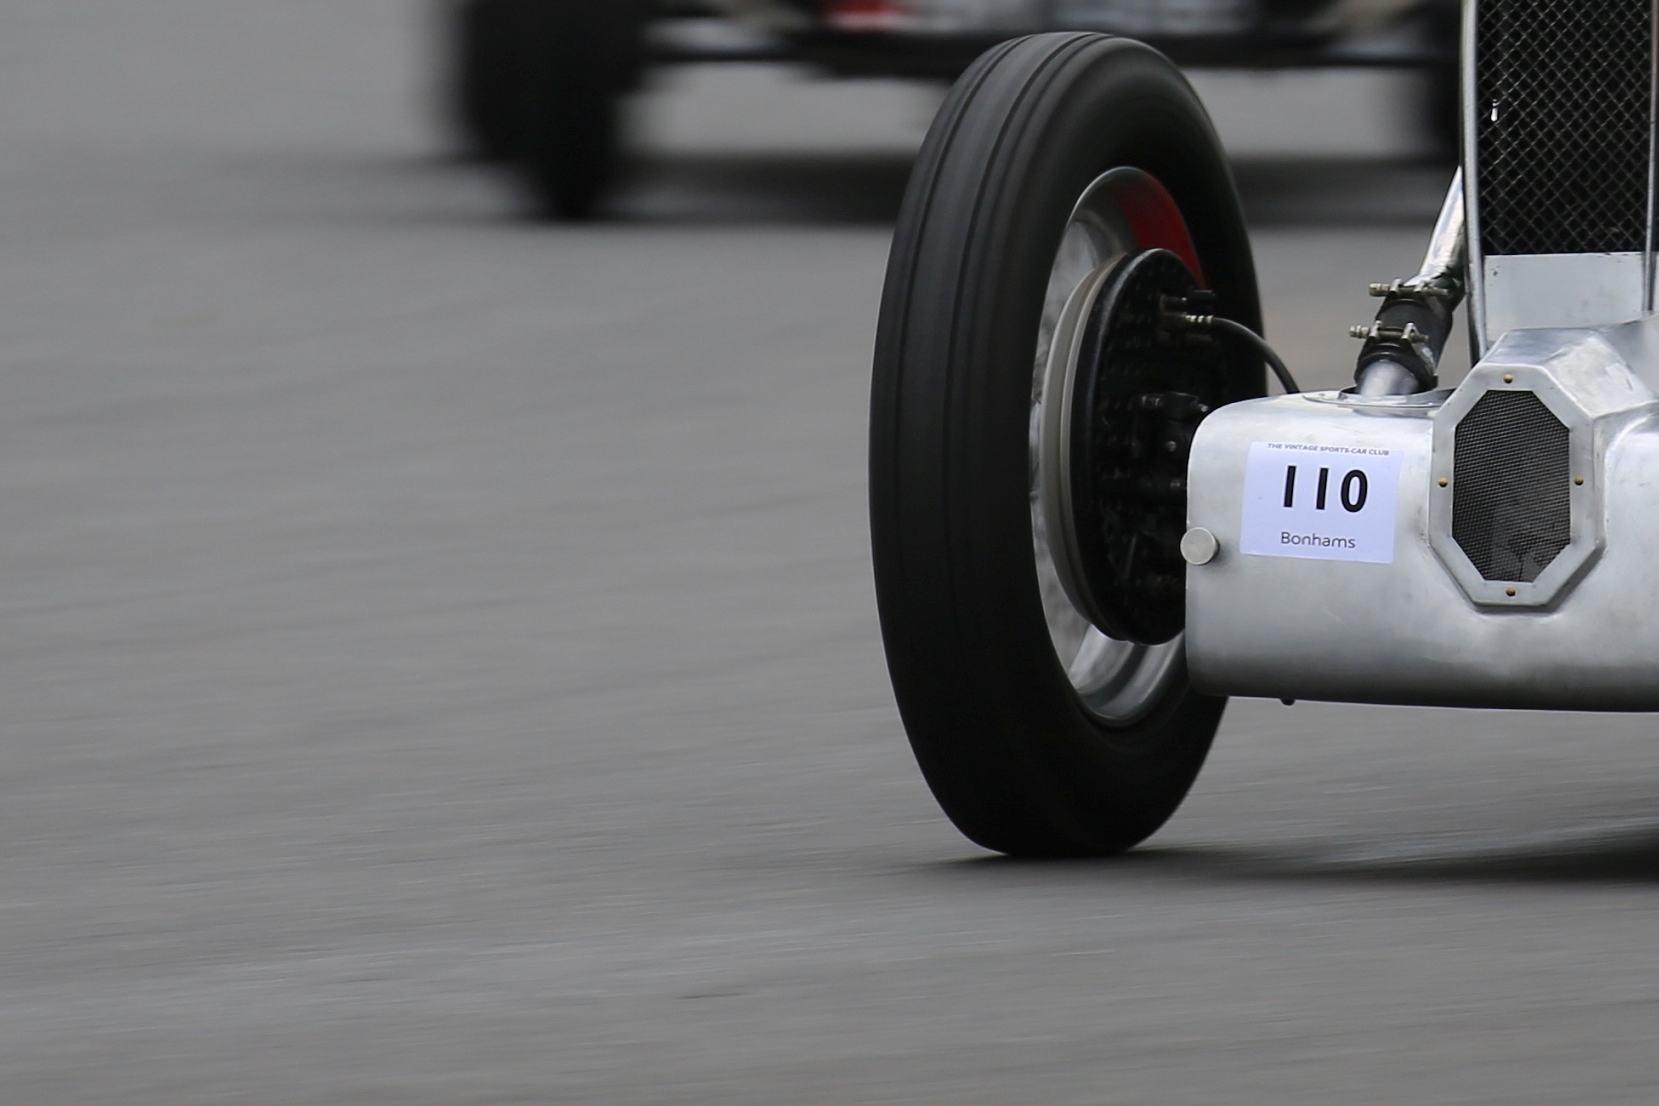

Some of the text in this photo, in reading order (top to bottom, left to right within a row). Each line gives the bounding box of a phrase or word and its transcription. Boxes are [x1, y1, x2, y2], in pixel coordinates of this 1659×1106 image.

[1284, 443, 1319, 452] VINTAGE
[1320, 446, 1367, 455] SPORTS-CAR
[1368, 448, 1390, 456] CLUB
[1283, 465, 1368, 513] 110
[1280, 531, 1356, 549] Bonhams
